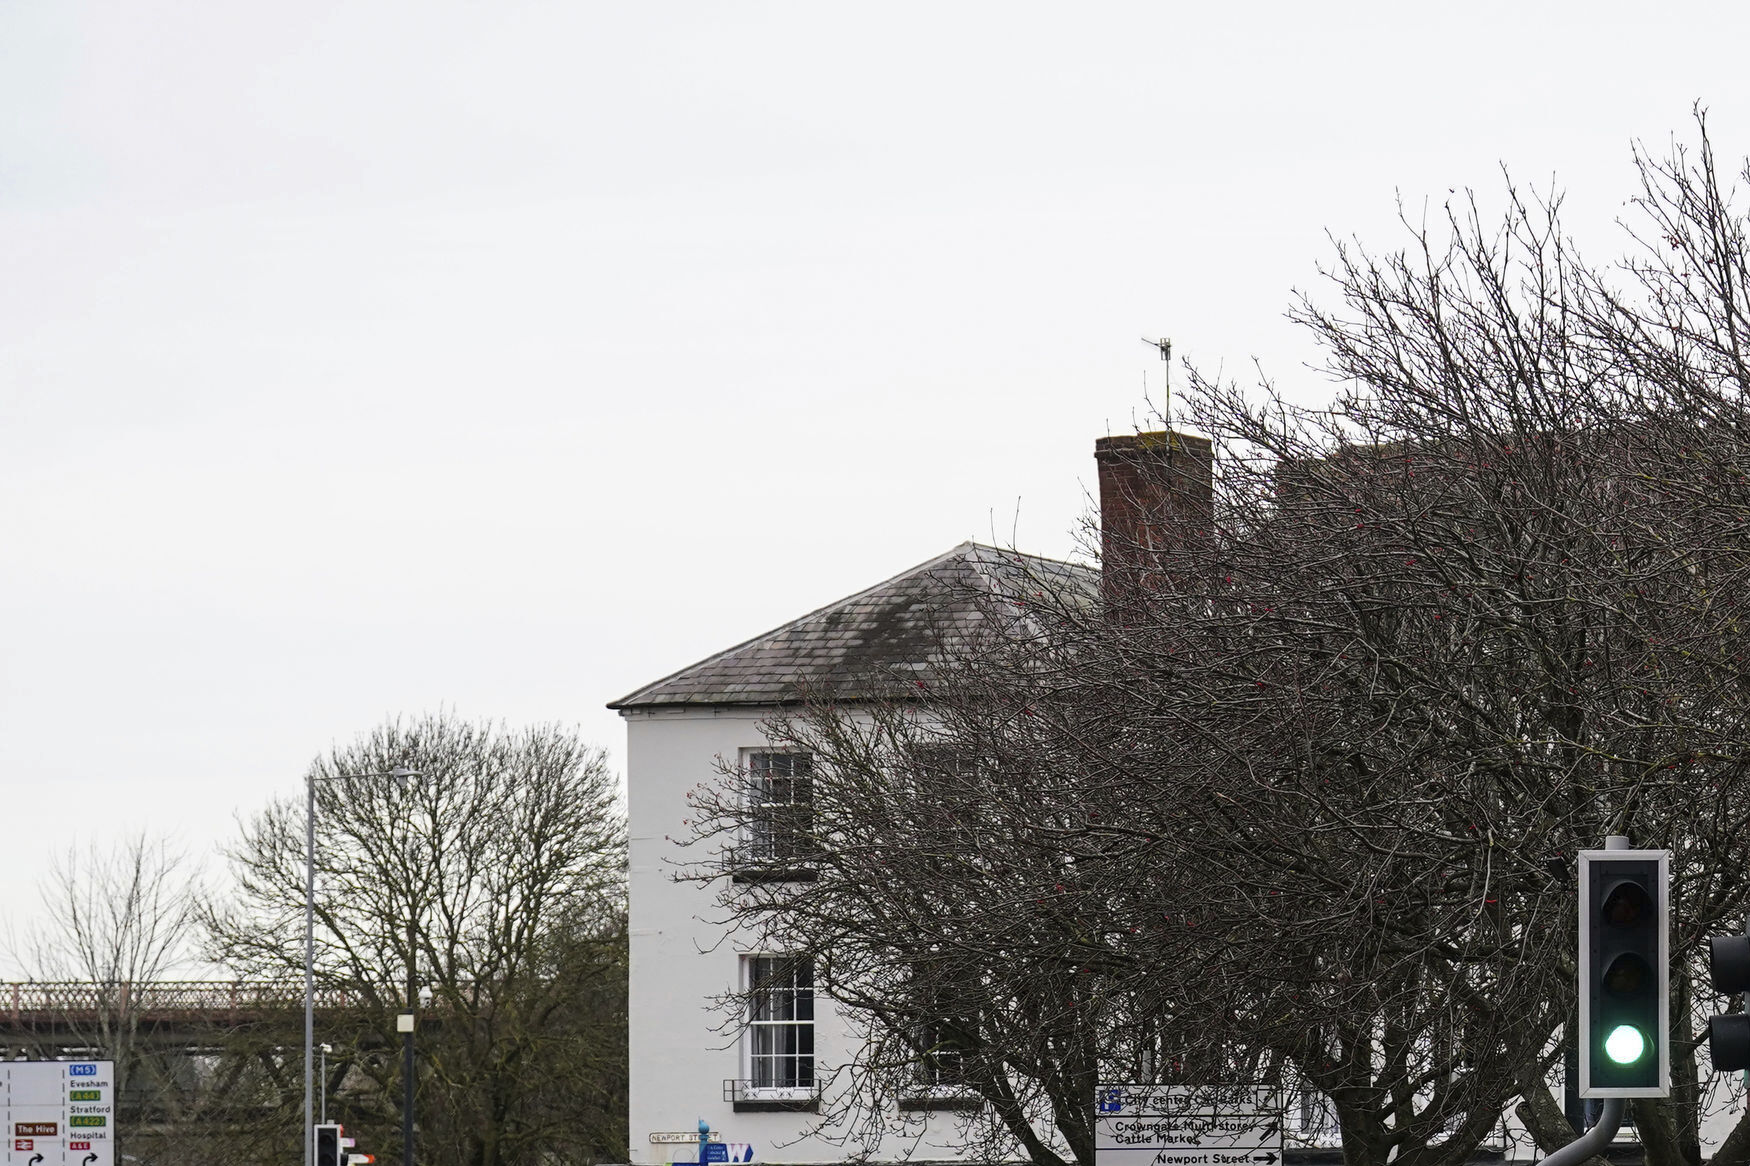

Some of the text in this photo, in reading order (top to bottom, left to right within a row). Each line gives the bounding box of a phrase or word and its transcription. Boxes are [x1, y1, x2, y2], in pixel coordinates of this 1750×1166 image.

[70, 1105, 110, 1113] Stratford
[17, 1125, 55, 1133] The Hive
[70, 1132, 106, 1140] Hospital
[1115, 1134, 1152, 1144] Cattle
[1157, 1154, 1250, 1166] Newport Street
